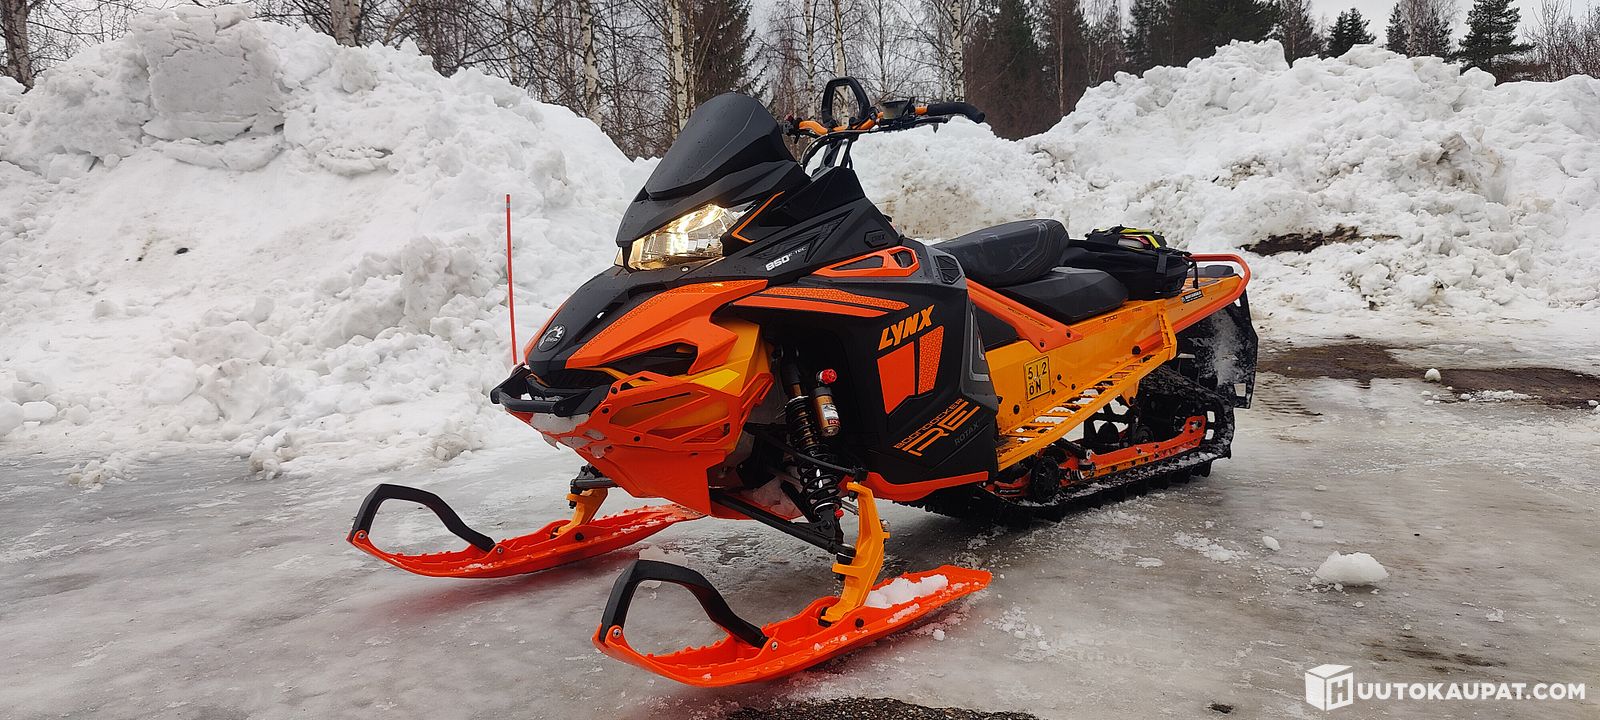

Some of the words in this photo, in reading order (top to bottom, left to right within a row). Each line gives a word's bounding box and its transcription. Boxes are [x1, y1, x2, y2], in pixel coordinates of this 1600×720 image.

[765, 254, 791, 271] 850
[878, 304, 935, 351] LYNX
[1027, 361, 1047, 380] 512
[893, 398, 965, 449] BOONDOCKER
[954, 420, 980, 446] ROTAX
